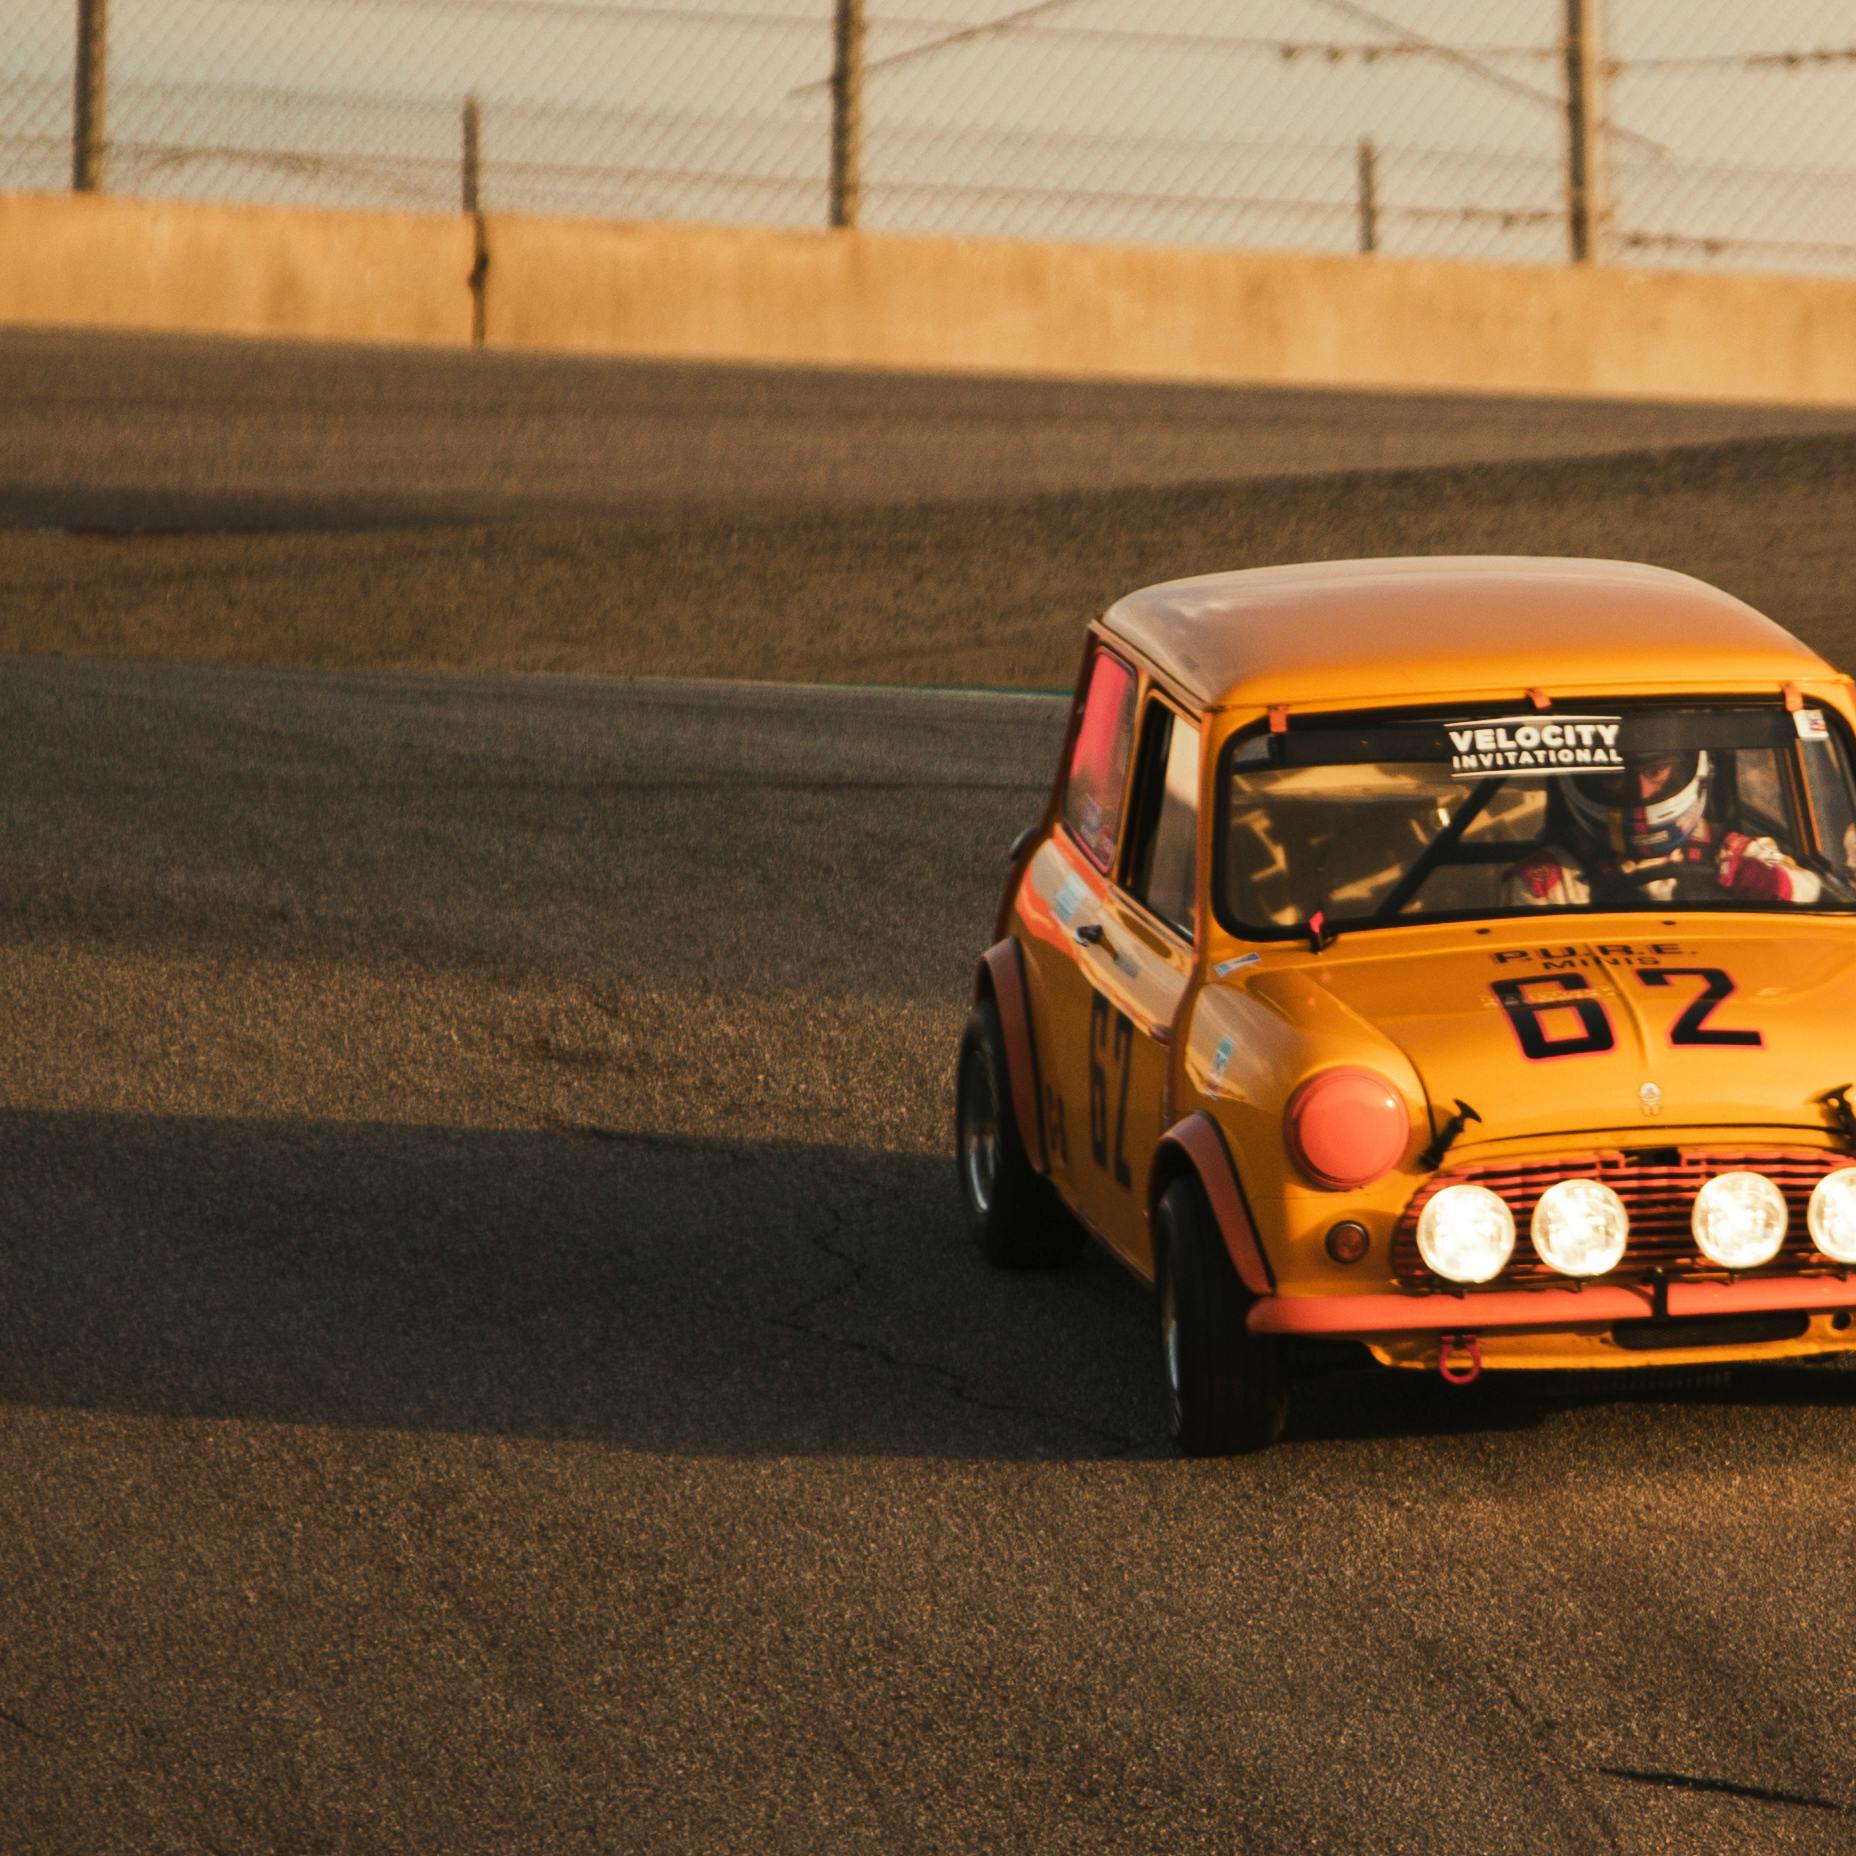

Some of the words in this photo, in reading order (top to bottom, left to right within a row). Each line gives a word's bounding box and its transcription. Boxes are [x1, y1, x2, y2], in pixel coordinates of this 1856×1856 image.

[1449, 724, 1620, 752] VELOCITY
[1452, 748, 1624, 770] INVITATIONAL
[1542, 955, 1661, 970] MINIS
[1489, 967, 1766, 1062] 62
[1090, 989, 1134, 1190] 62
